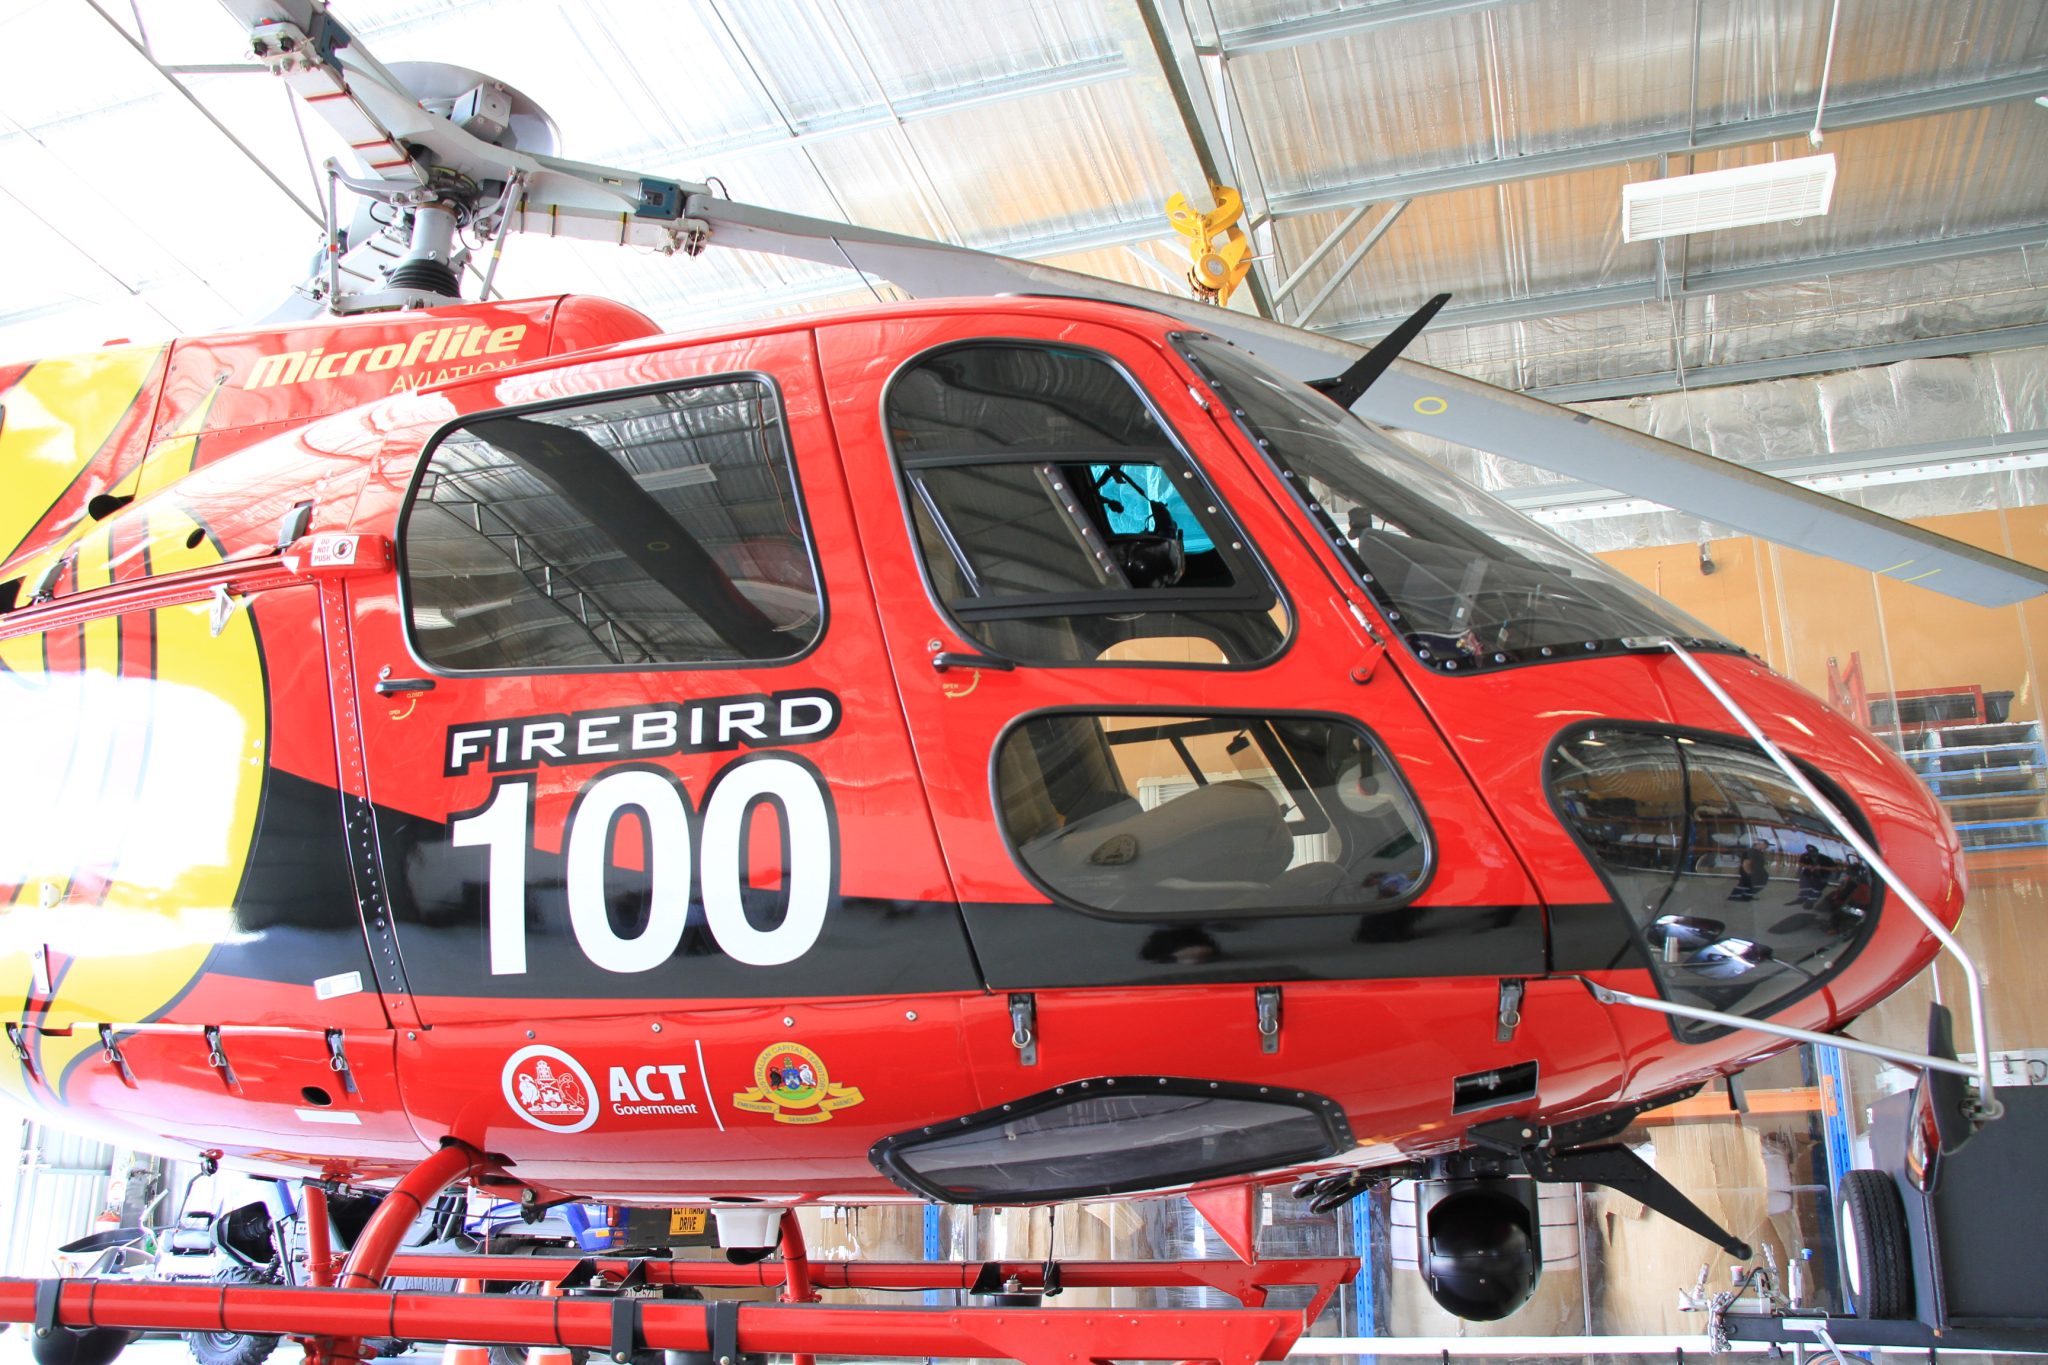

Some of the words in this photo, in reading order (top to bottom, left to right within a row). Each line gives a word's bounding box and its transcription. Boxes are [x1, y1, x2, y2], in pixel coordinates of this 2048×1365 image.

[243, 324, 526, 390] Microflite
[451, 696, 833, 768] FIREBIRD
[452, 758, 831, 976] 100
[609, 1065, 686, 1102] ACT
[613, 1103, 698, 1115] Government
[736, 1101, 773, 1111] EMERGENCY
[787, 1115, 820, 1123] SERVICES
[832, 1097, 856, 1108] AGENCY
[679, 1216, 697, 1231] DRIVE
[404, 1276, 445, 1292] YAMAHA
